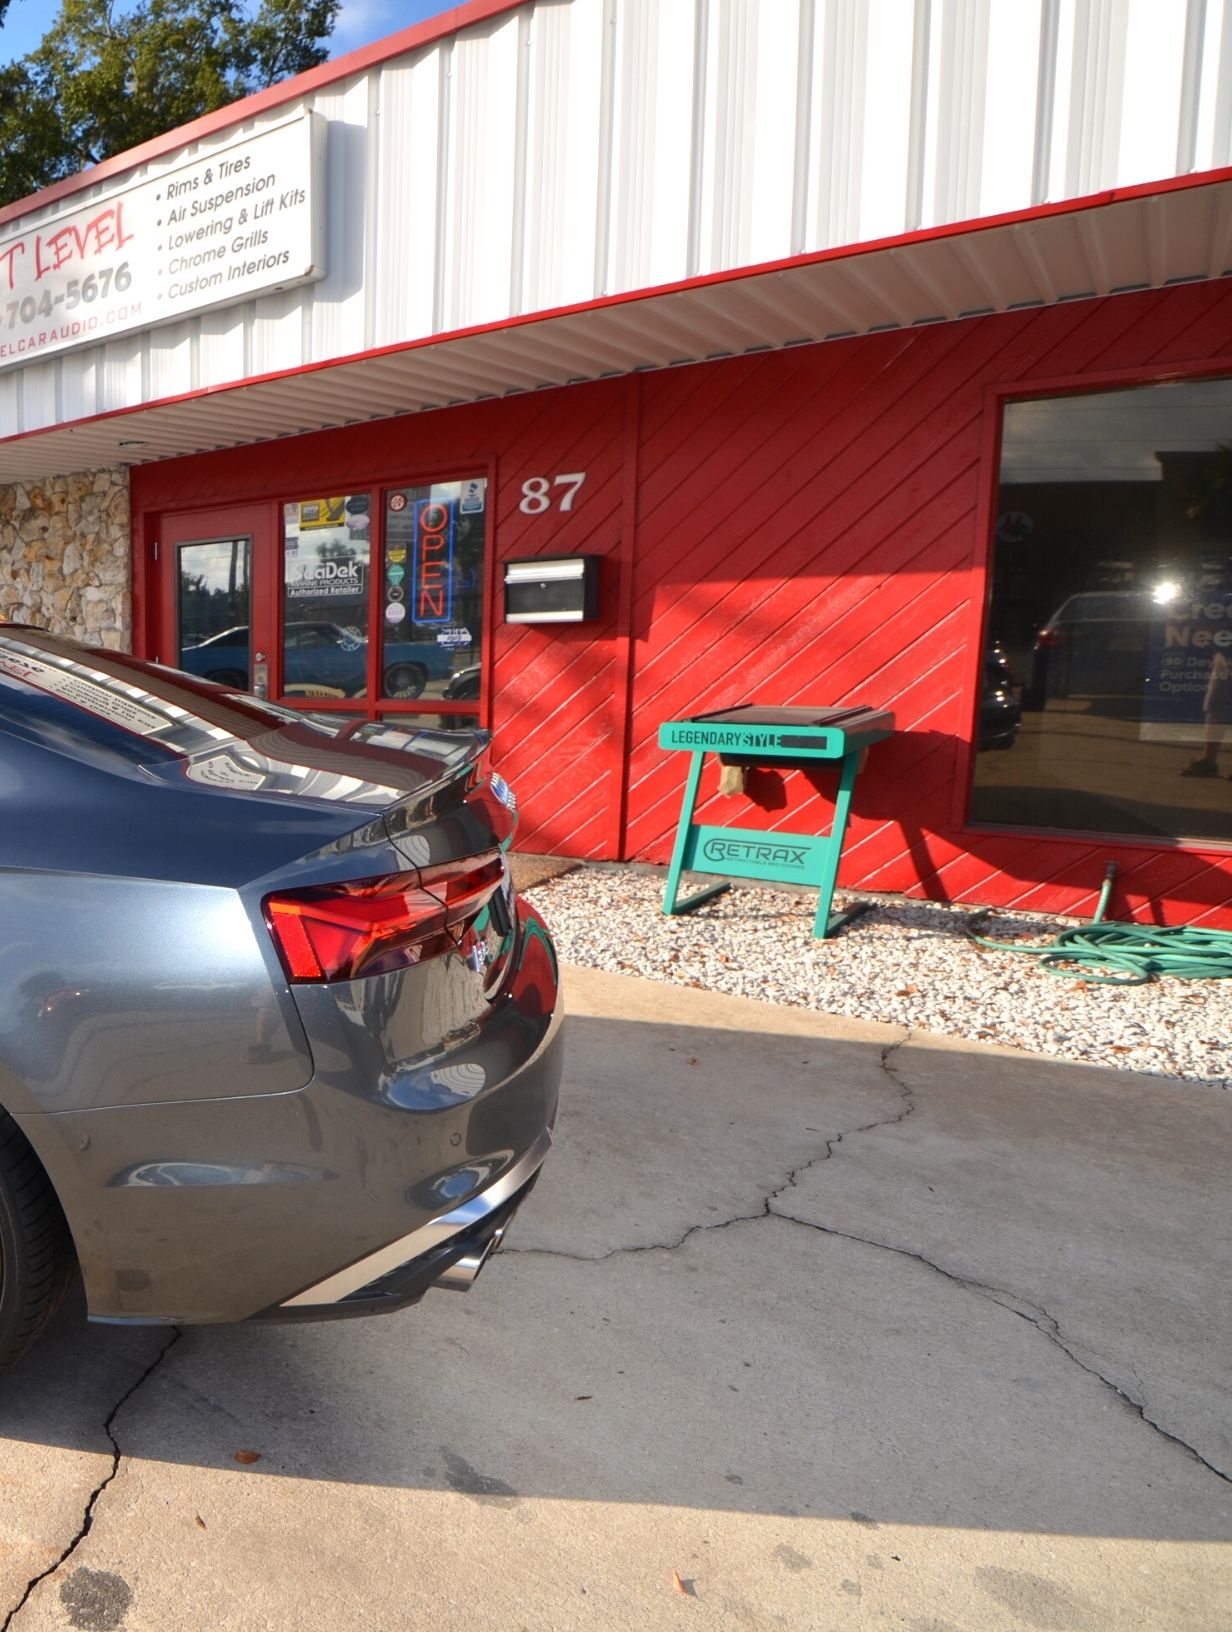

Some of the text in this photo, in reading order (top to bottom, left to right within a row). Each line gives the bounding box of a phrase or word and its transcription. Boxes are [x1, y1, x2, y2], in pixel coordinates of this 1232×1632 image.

[167, 155, 251, 201] Rims & Tires
[167, 173, 276, 227] Air Suspension
[35, 201, 135, 282] LEVEL
[168, 188, 306, 251] Lowering & Lift Kits
[169, 229, 269, 275] Chrome Grills
[169, 249, 290, 300] Custom Interiors
[519, 471, 586, 515] 87
[294, 560, 359, 581] SeaDek
[419, 503, 448, 617] OPEN
[290, 585, 360, 597] Authorized Retailer
[671, 729, 742, 746] LEGENDARY
[703, 838, 811, 865] RETRAX
